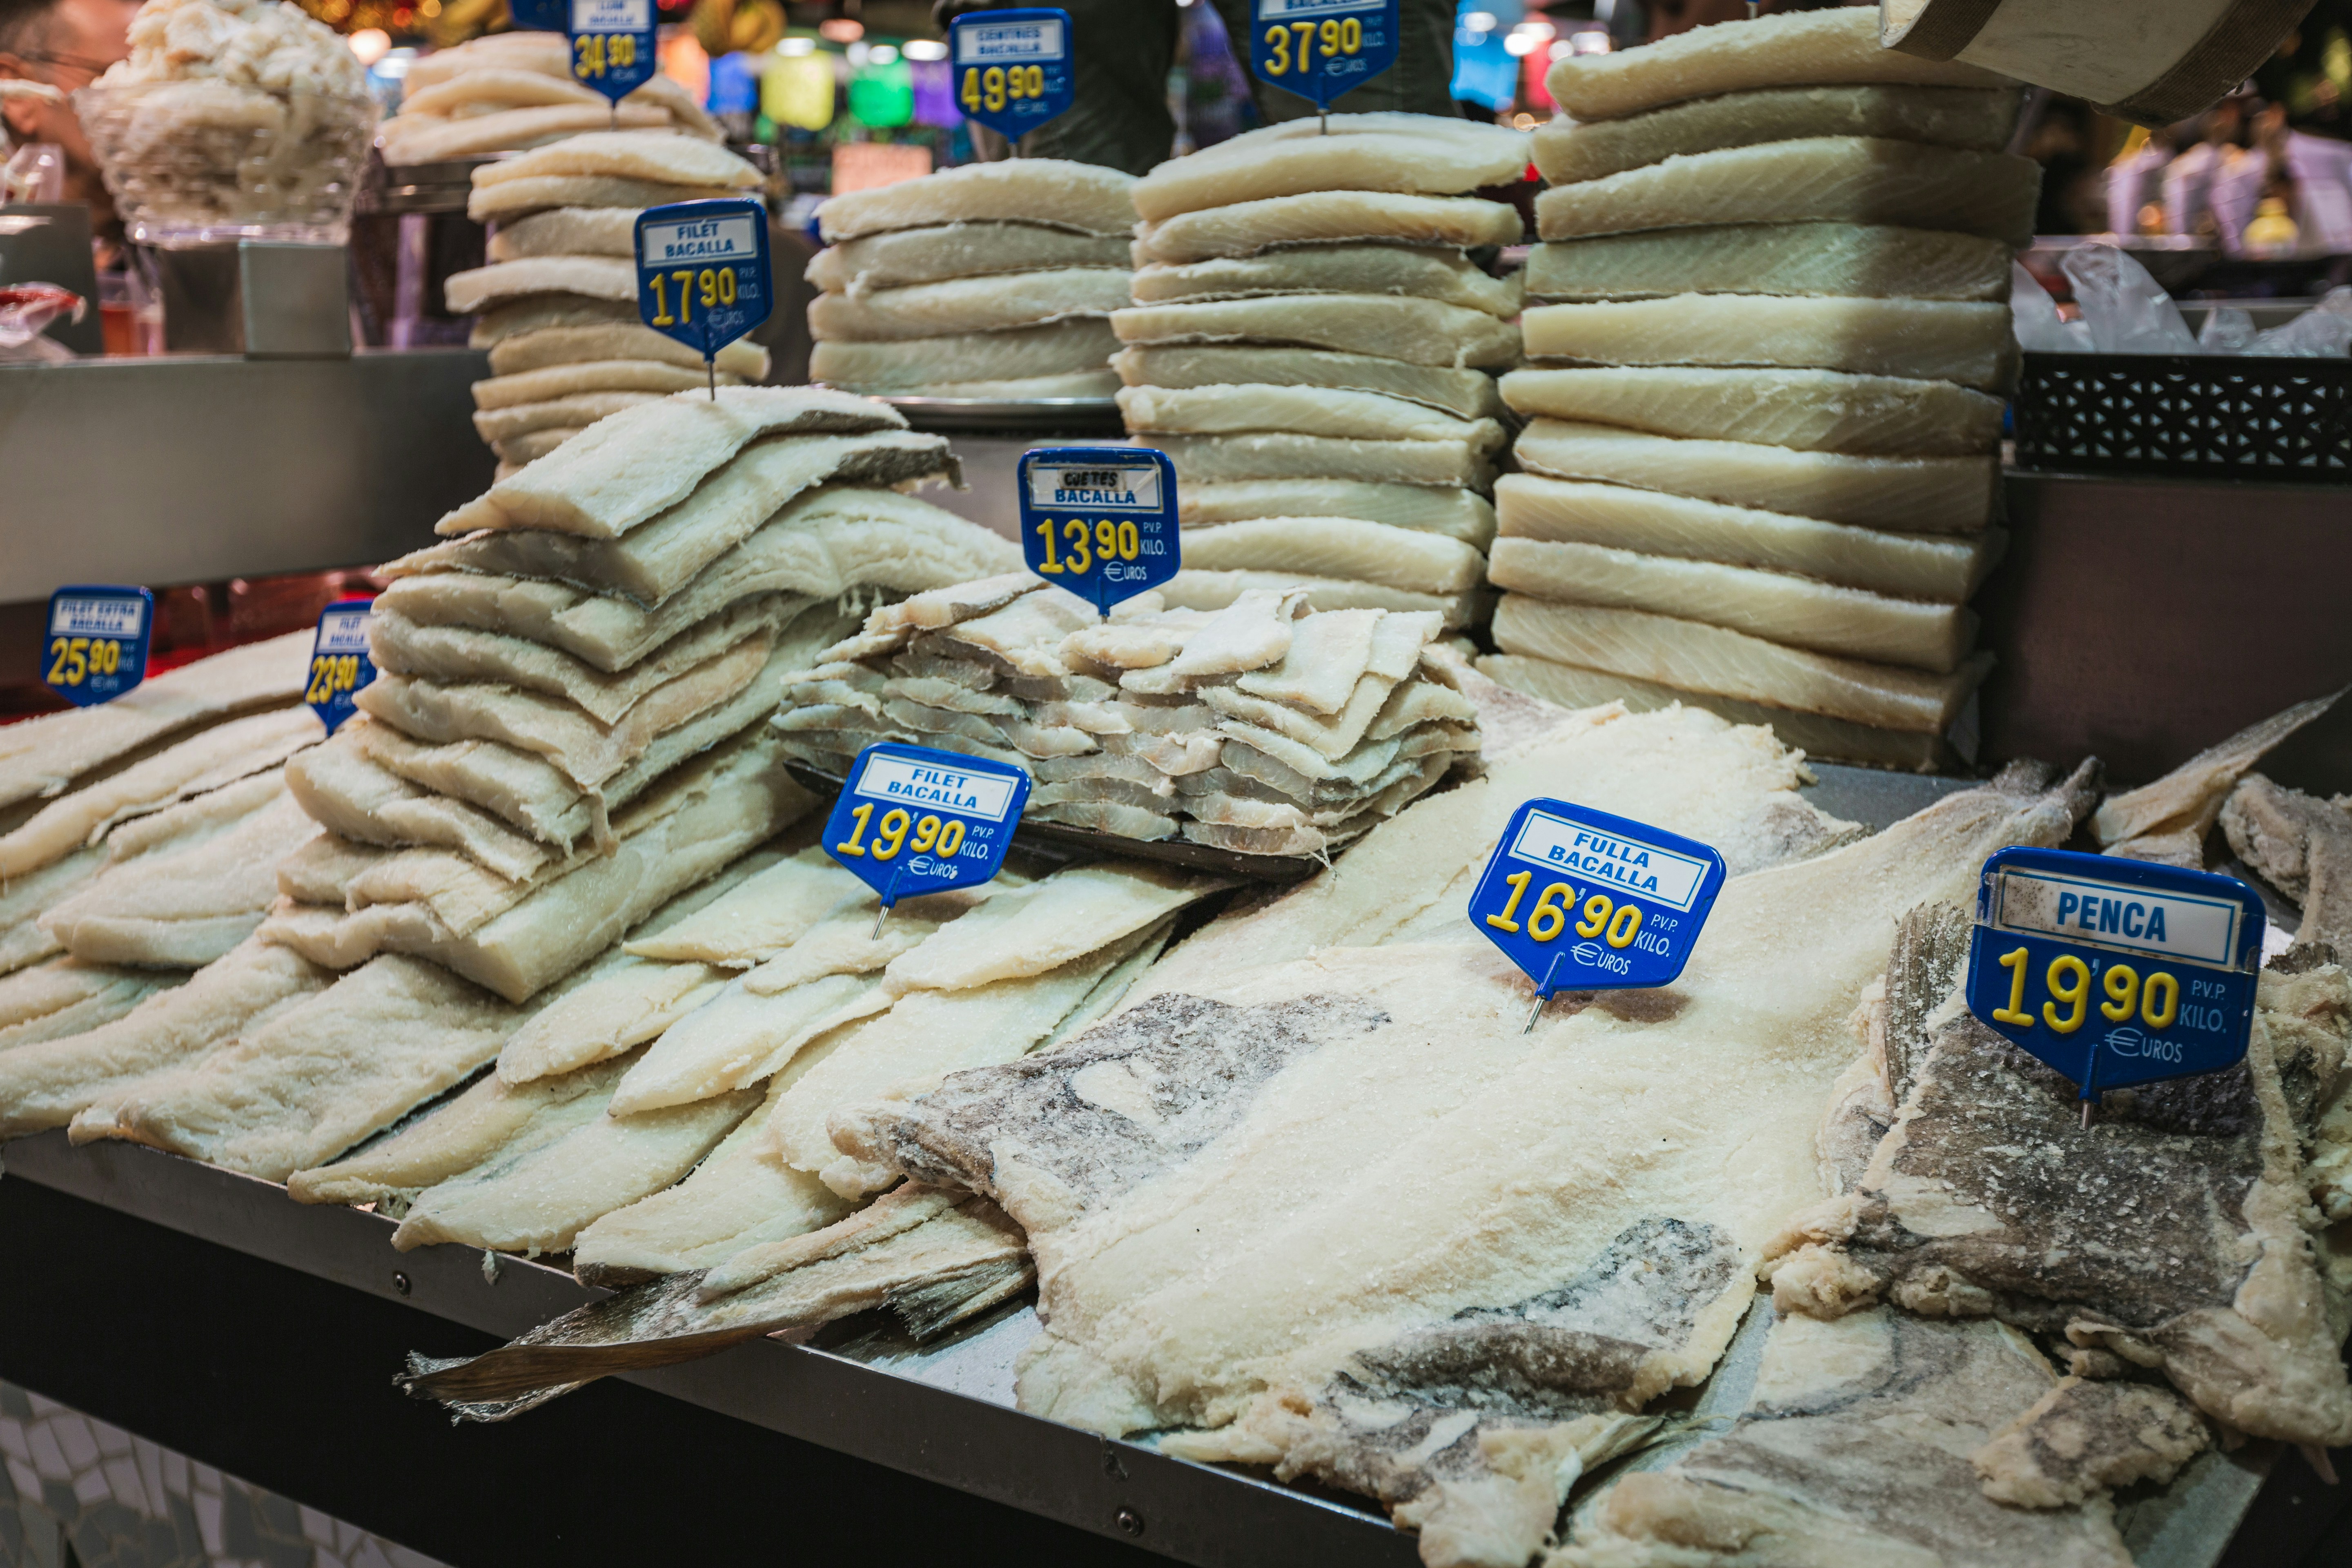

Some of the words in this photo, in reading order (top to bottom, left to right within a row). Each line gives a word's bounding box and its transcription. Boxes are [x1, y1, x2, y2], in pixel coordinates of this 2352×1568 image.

[677, 223, 719, 240] FILET
[666, 238, 734, 257] BACALLA
[1055, 489, 1136, 503] BACALLA
[911, 768, 969, 788] FILET
[887, 782, 977, 808] BACALLA
[1574, 833, 1649, 868] FULLA
[1548, 845, 1658, 892] BACALLA
[2058, 892, 2166, 942] PENCA
